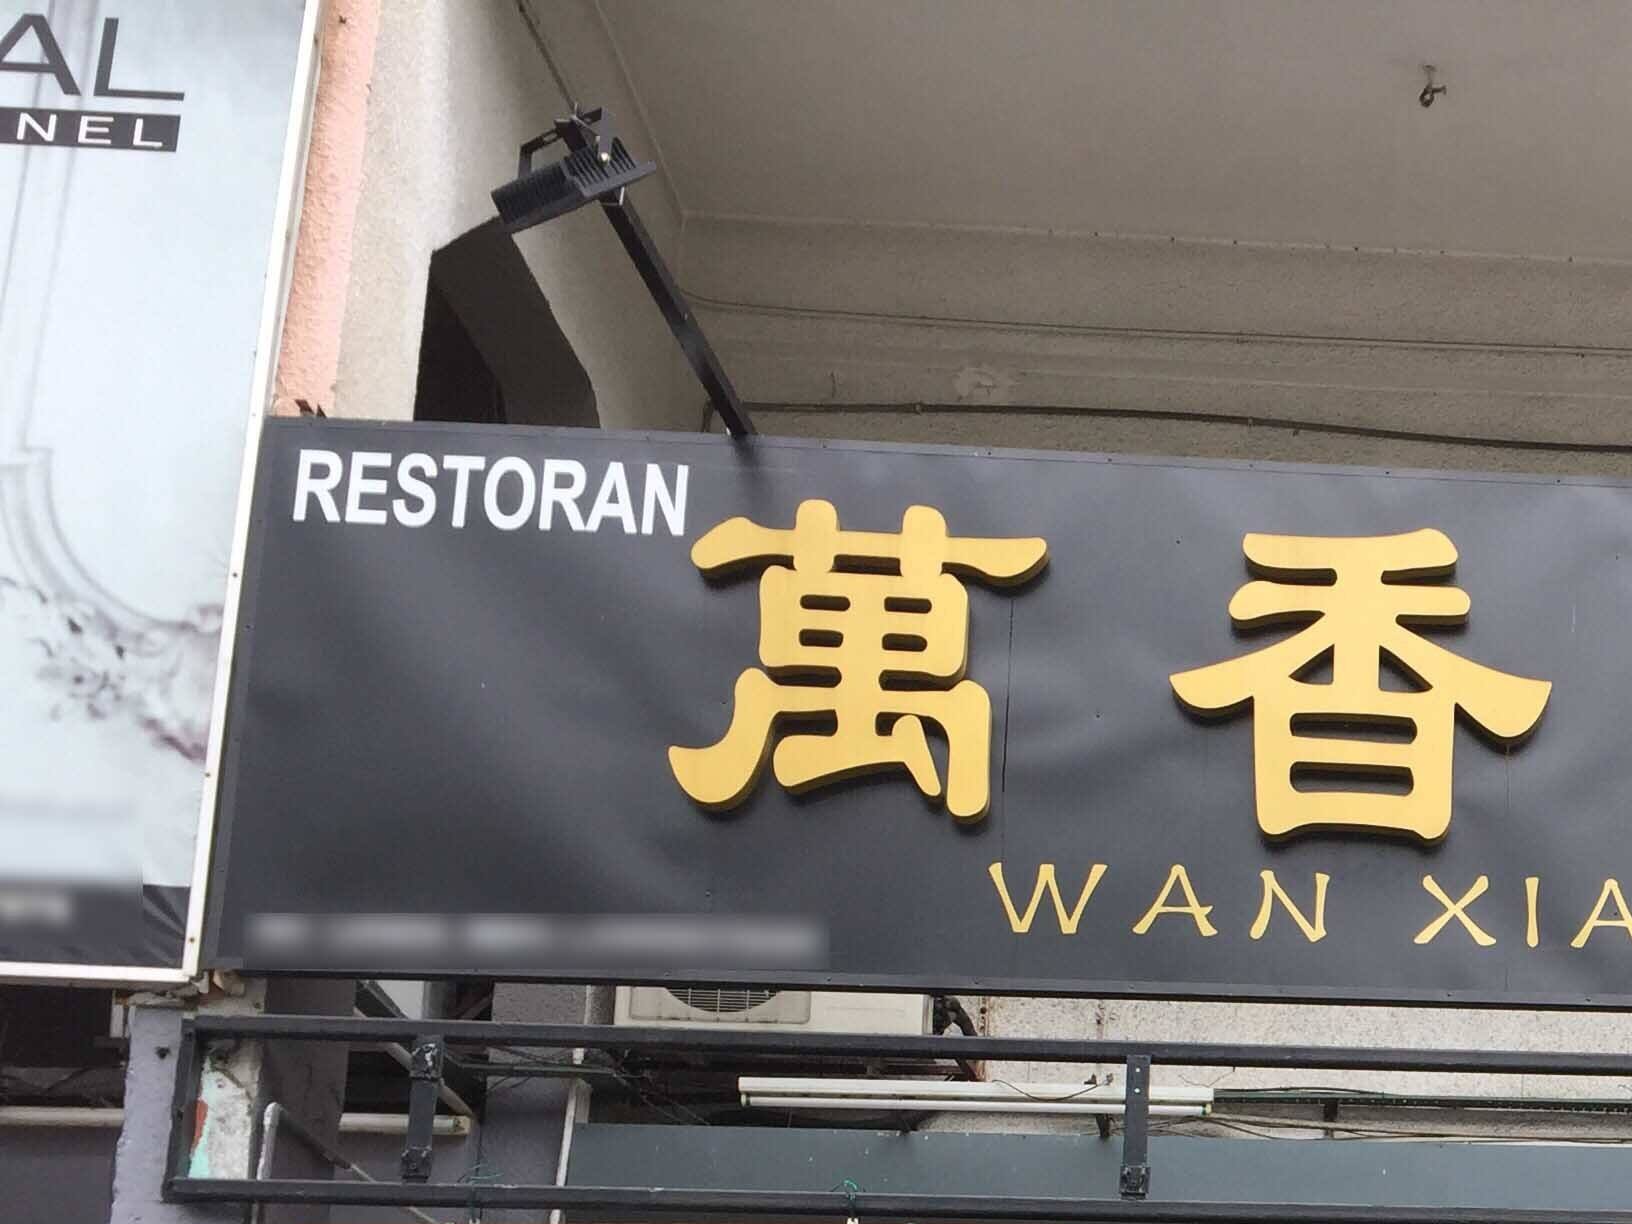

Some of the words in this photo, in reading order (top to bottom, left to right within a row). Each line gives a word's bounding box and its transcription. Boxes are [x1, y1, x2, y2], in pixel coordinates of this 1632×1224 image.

[0, 13, 185, 101] AL
[16, 112, 163, 147] NEL
[292, 448, 690, 536] RESTORAN
[987, 862, 1329, 943] WAN
